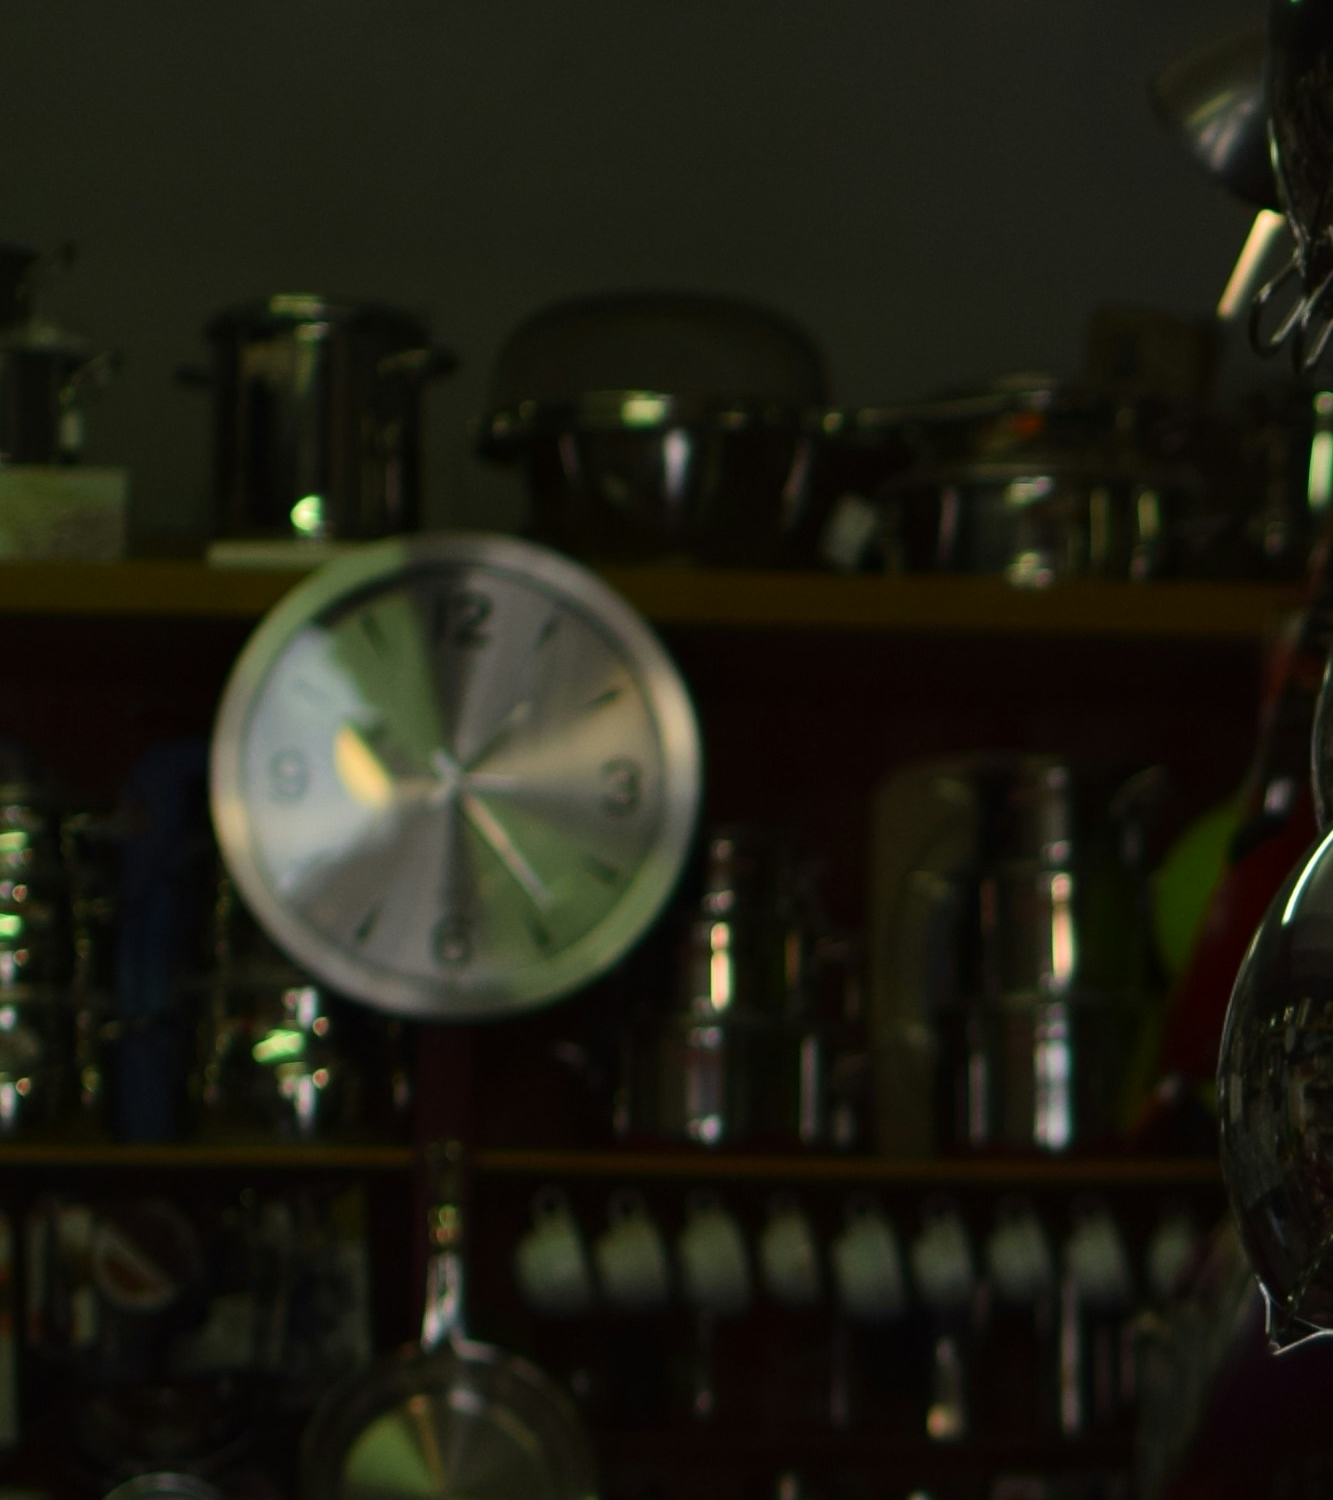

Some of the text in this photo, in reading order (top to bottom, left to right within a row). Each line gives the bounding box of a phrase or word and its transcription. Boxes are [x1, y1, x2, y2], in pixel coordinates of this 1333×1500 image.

[432, 592, 492, 648] 12
[602, 759, 642, 816] 3
[433, 912, 471, 969] 6
